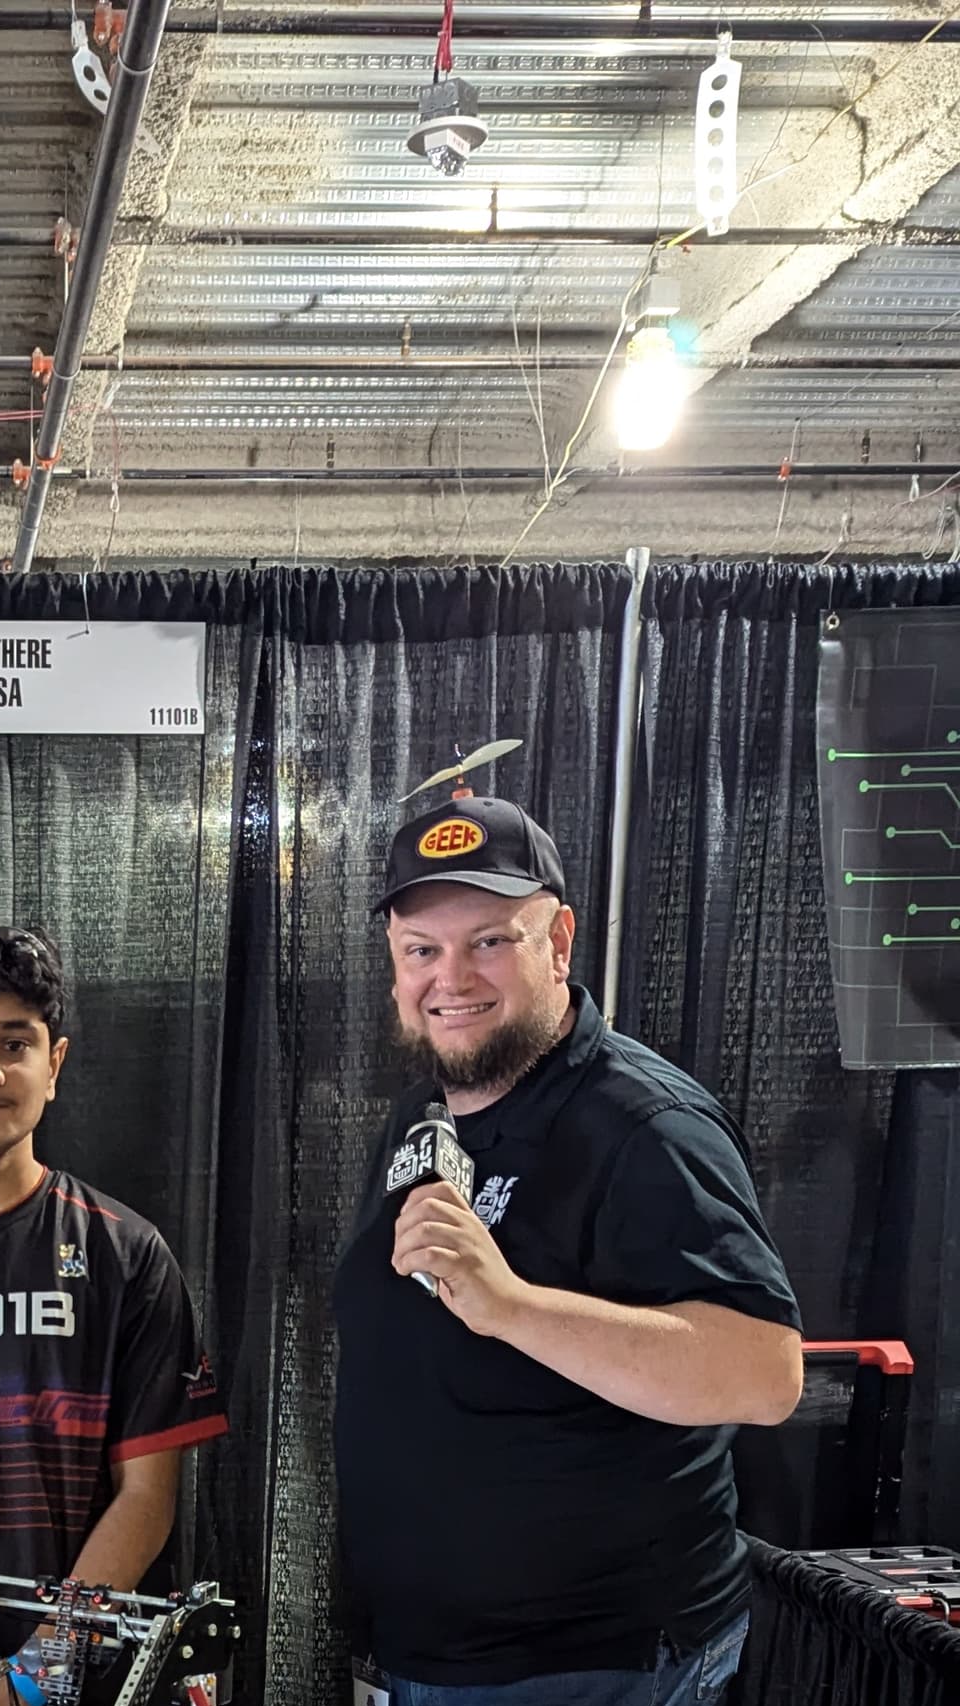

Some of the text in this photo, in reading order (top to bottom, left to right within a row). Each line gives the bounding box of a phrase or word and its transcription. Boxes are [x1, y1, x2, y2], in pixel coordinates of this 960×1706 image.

[149, 706, 199, 727] 11101B
[424, 824, 478, 852] GEEK
[418, 1131, 434, 1176] FUN
